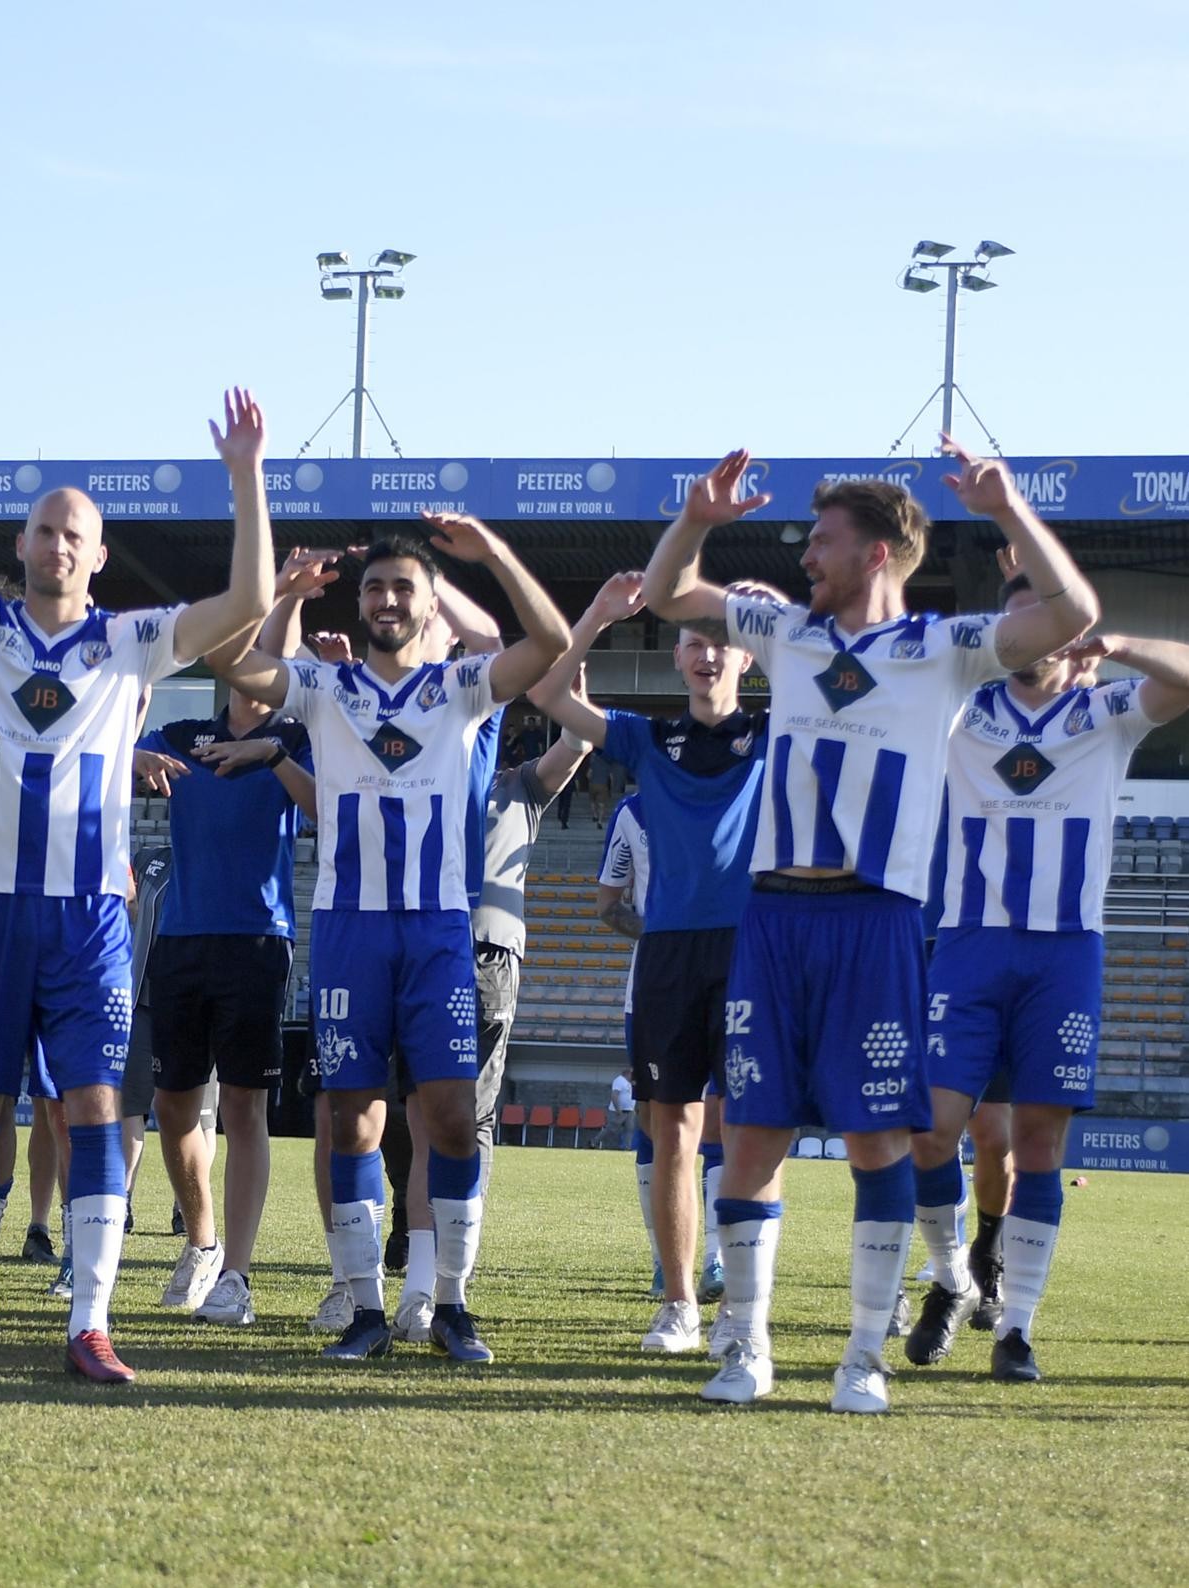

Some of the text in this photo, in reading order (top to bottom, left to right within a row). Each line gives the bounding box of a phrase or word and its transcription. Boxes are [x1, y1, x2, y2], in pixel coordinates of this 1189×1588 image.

[88, 474, 150, 492] PEETERS
[371, 473, 436, 490] PEETERS
[517, 473, 582, 490] PEETERS
[1009, 472, 1066, 502] MANS
[4, 503, 29, 514] VOOR
[107, 503, 126, 514] ZIJN
[128, 503, 141, 514] ER
[143, 503, 168, 514] VOOR
[171, 503, 181, 514] U.
[270, 502, 323, 513] ER VOOR U.
[371, 502, 388, 513] WIJ
[390, 502, 410, 513] ZIJN
[412, 502, 426, 514] ER
[429, 502, 455, 513] VOOR
[517, 502, 615, 514] WIJ ZIJN ER VOOR U.
[33, 659, 61, 672] JAKO
[830, 671, 859, 690] JB
[29, 688, 58, 709] JB
[814, 718, 866, 735] SERVICE
[869, 728, 888, 738] BV
[982, 721, 1010, 739] B&R
[194, 734, 215, 742] JAKO
[1016, 733, 1041, 743] JAKO
[383, 740, 405, 757] JB
[1011, 760, 1037, 777] JB
[421, 778, 436, 786] BV
[1002, 801, 1051, 811] SERVICE
[1054, 802, 1071, 811] BV
[320, 988, 350, 1020] 10
[449, 1036, 477, 1051] asb
[1061, 1081, 1087, 1091] JAKO
[1083, 1132, 1140, 1149] PEETERS
[1082, 1157, 1169, 1170] WIJ ZIJN ER VOOR U.
[334, 1217, 361, 1227] AKO
[728, 1240, 765, 1248] JAKO
[860, 1243, 900, 1253] JAKO
[1010, 1236, 1045, 1247] JAKO
